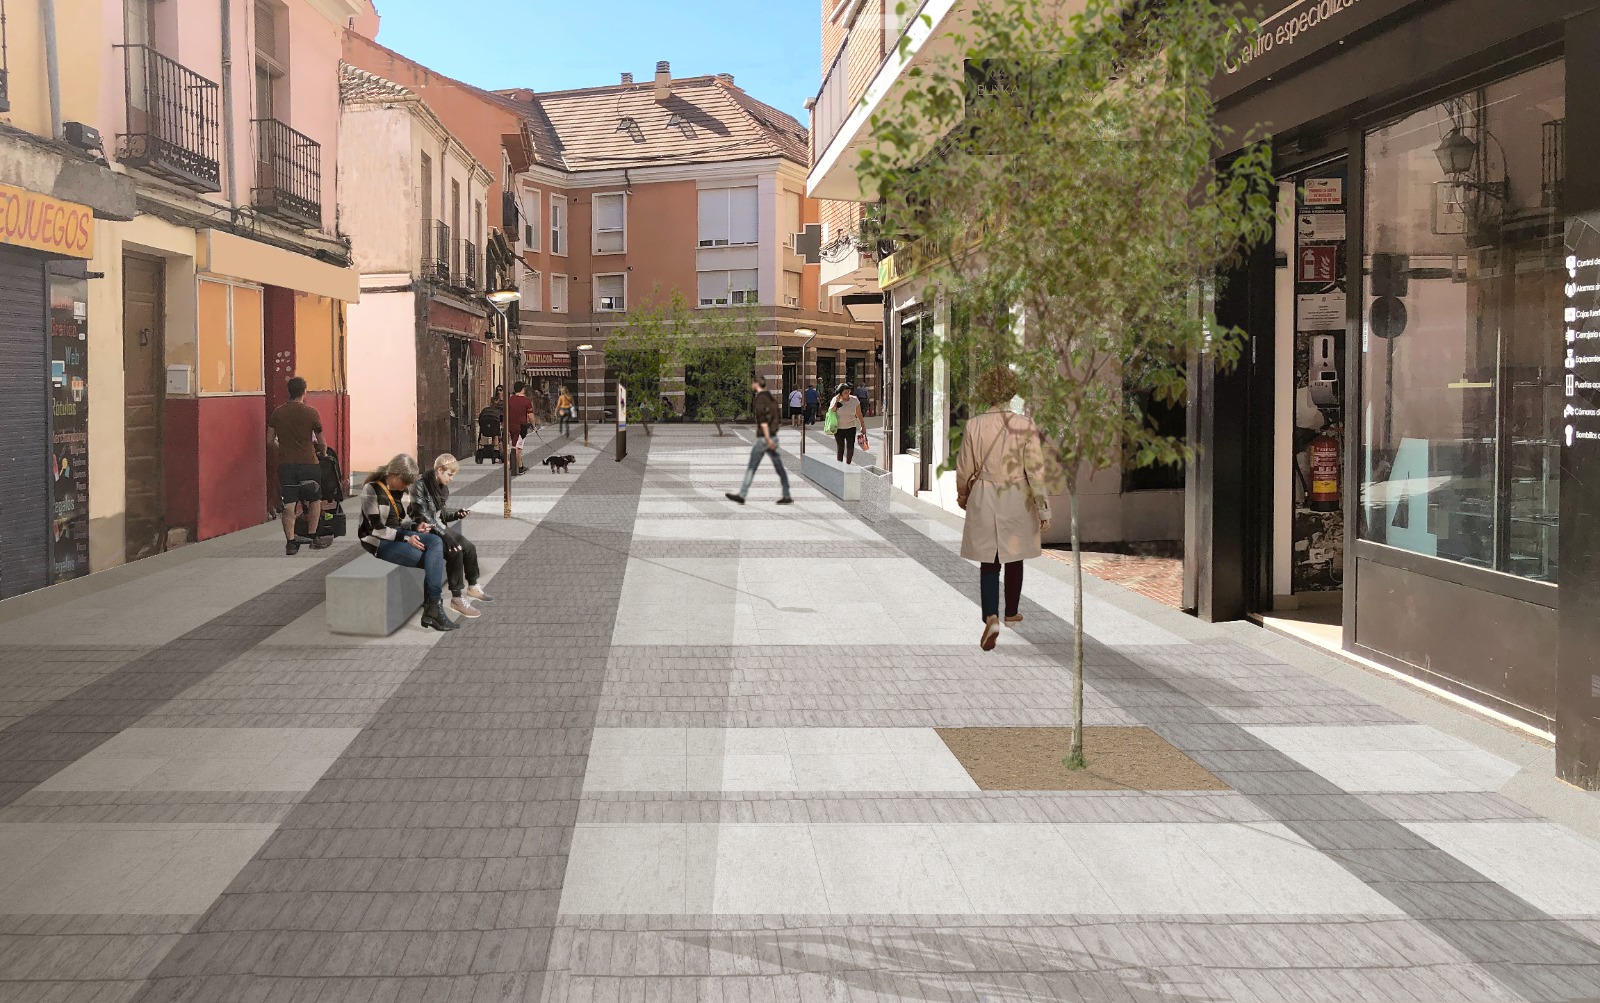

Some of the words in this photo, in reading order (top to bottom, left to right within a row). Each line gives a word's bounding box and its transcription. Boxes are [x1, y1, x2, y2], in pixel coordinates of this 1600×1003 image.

[1224, 24, 1273, 74] Centro
[1275, 0, 1358, 45] especializa
[1577, 259, 1594, 268] Control
[1576, 310, 1590, 319] Cajas
[52, 427, 86, 444] erchandising
[55, 494, 75, 516] egalos
[54, 555, 75, 577] egalos
